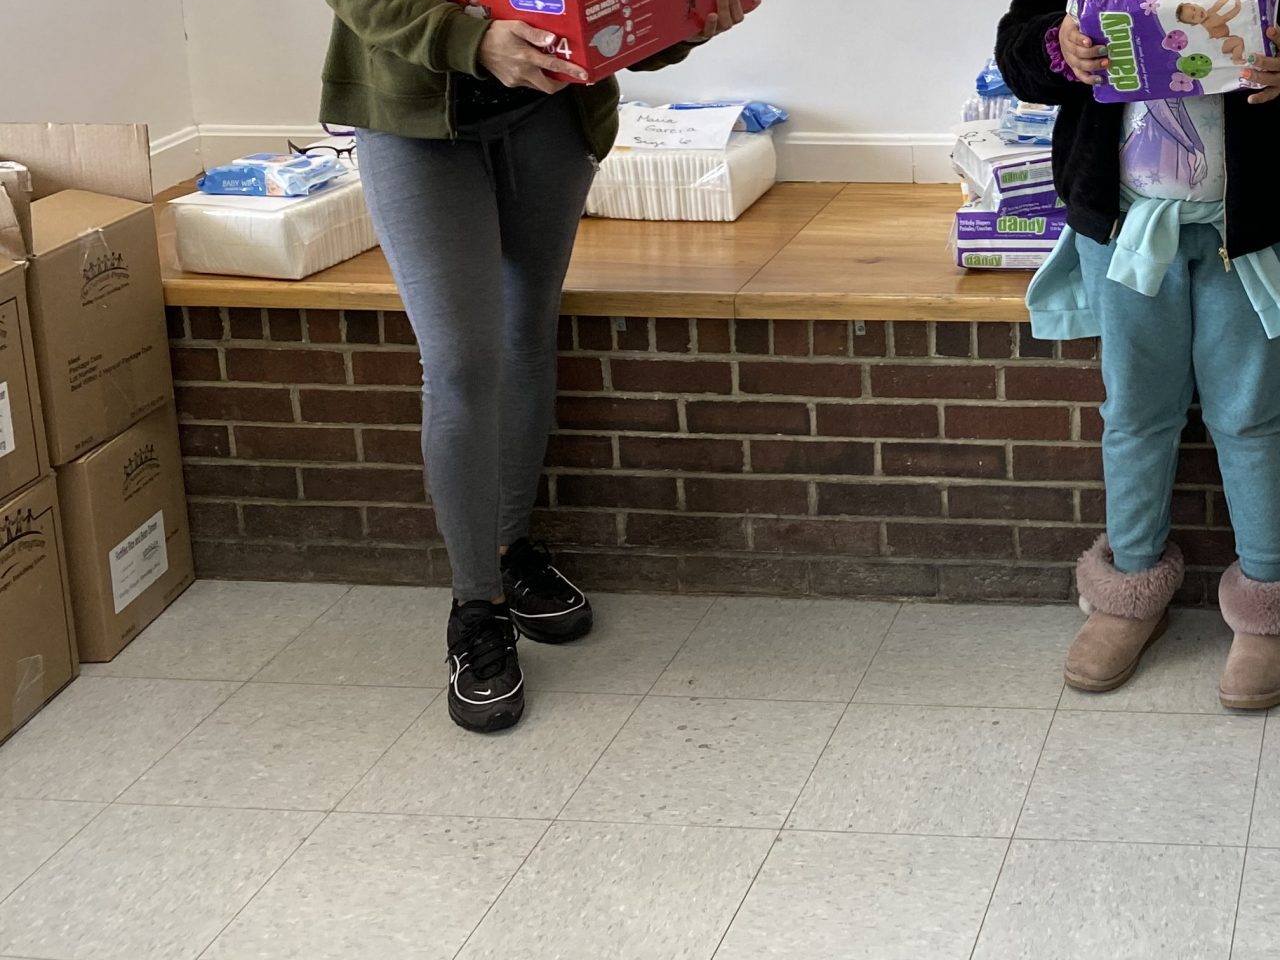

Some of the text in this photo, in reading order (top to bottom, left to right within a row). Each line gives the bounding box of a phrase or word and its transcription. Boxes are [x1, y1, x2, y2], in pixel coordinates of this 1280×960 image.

[556, 37, 572, 60] 4
[1099, 12, 1141, 92] dandy
[222, 179, 239, 187] BABY
[997, 216, 1046, 234] dandy
[964, 254, 1002, 267] dandy
